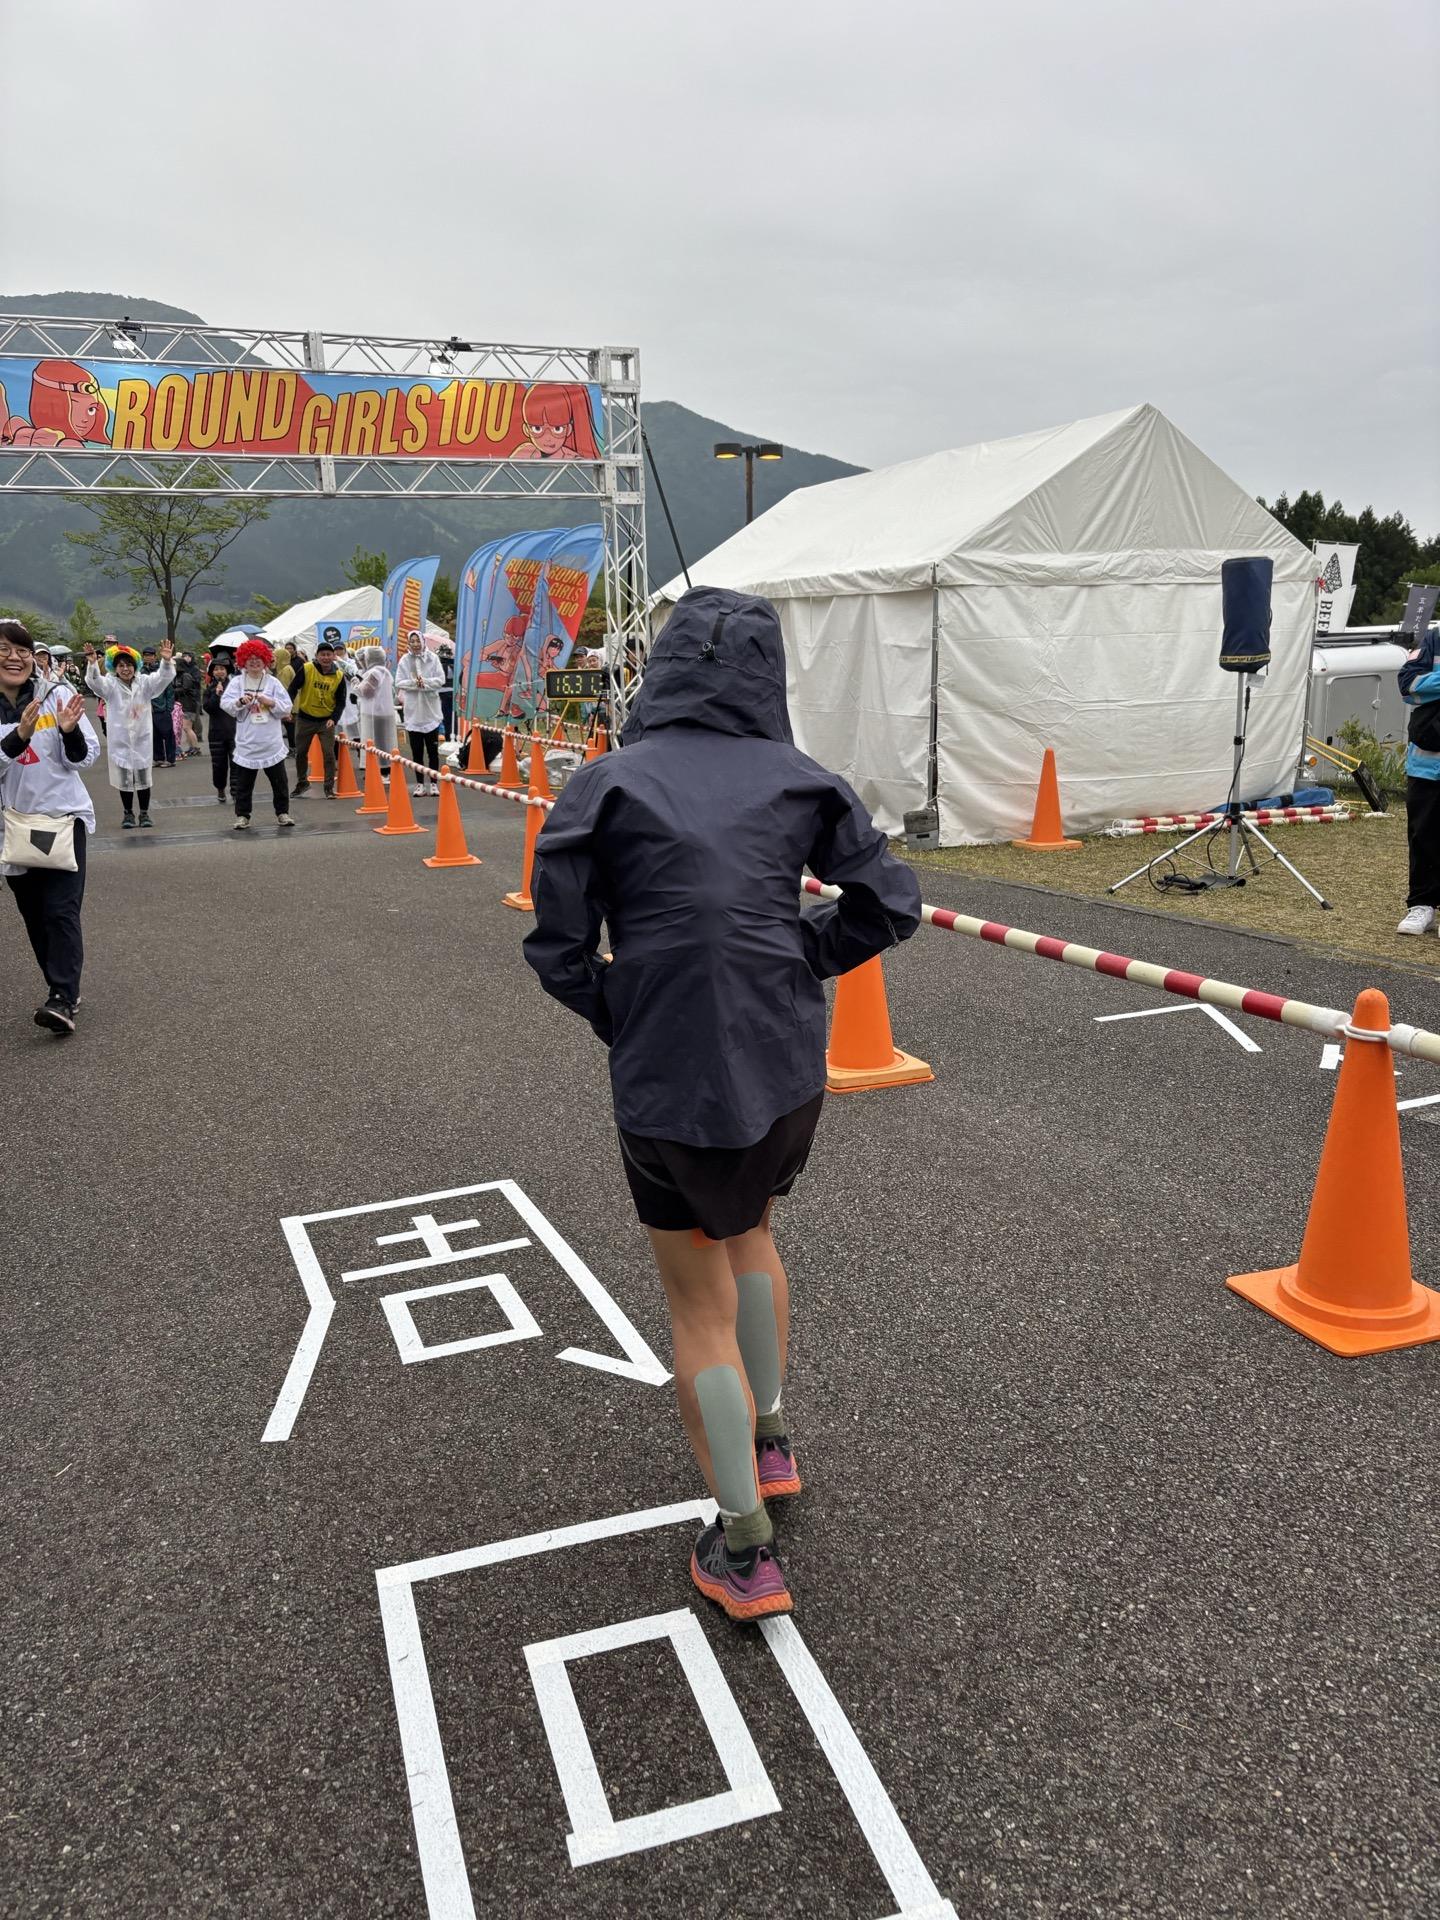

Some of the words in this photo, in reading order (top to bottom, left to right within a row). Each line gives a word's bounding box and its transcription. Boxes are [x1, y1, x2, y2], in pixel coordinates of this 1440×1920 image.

[112, 370, 298, 450] ROUND
[299, 384, 433, 455] GIRLS
[438, 379, 517, 447] 100
[548, 565, 589, 586] ROUND
[402, 576, 422, 629] ROUND
[548, 582, 583, 602] GIRLS
[558, 601, 580, 618] 100
